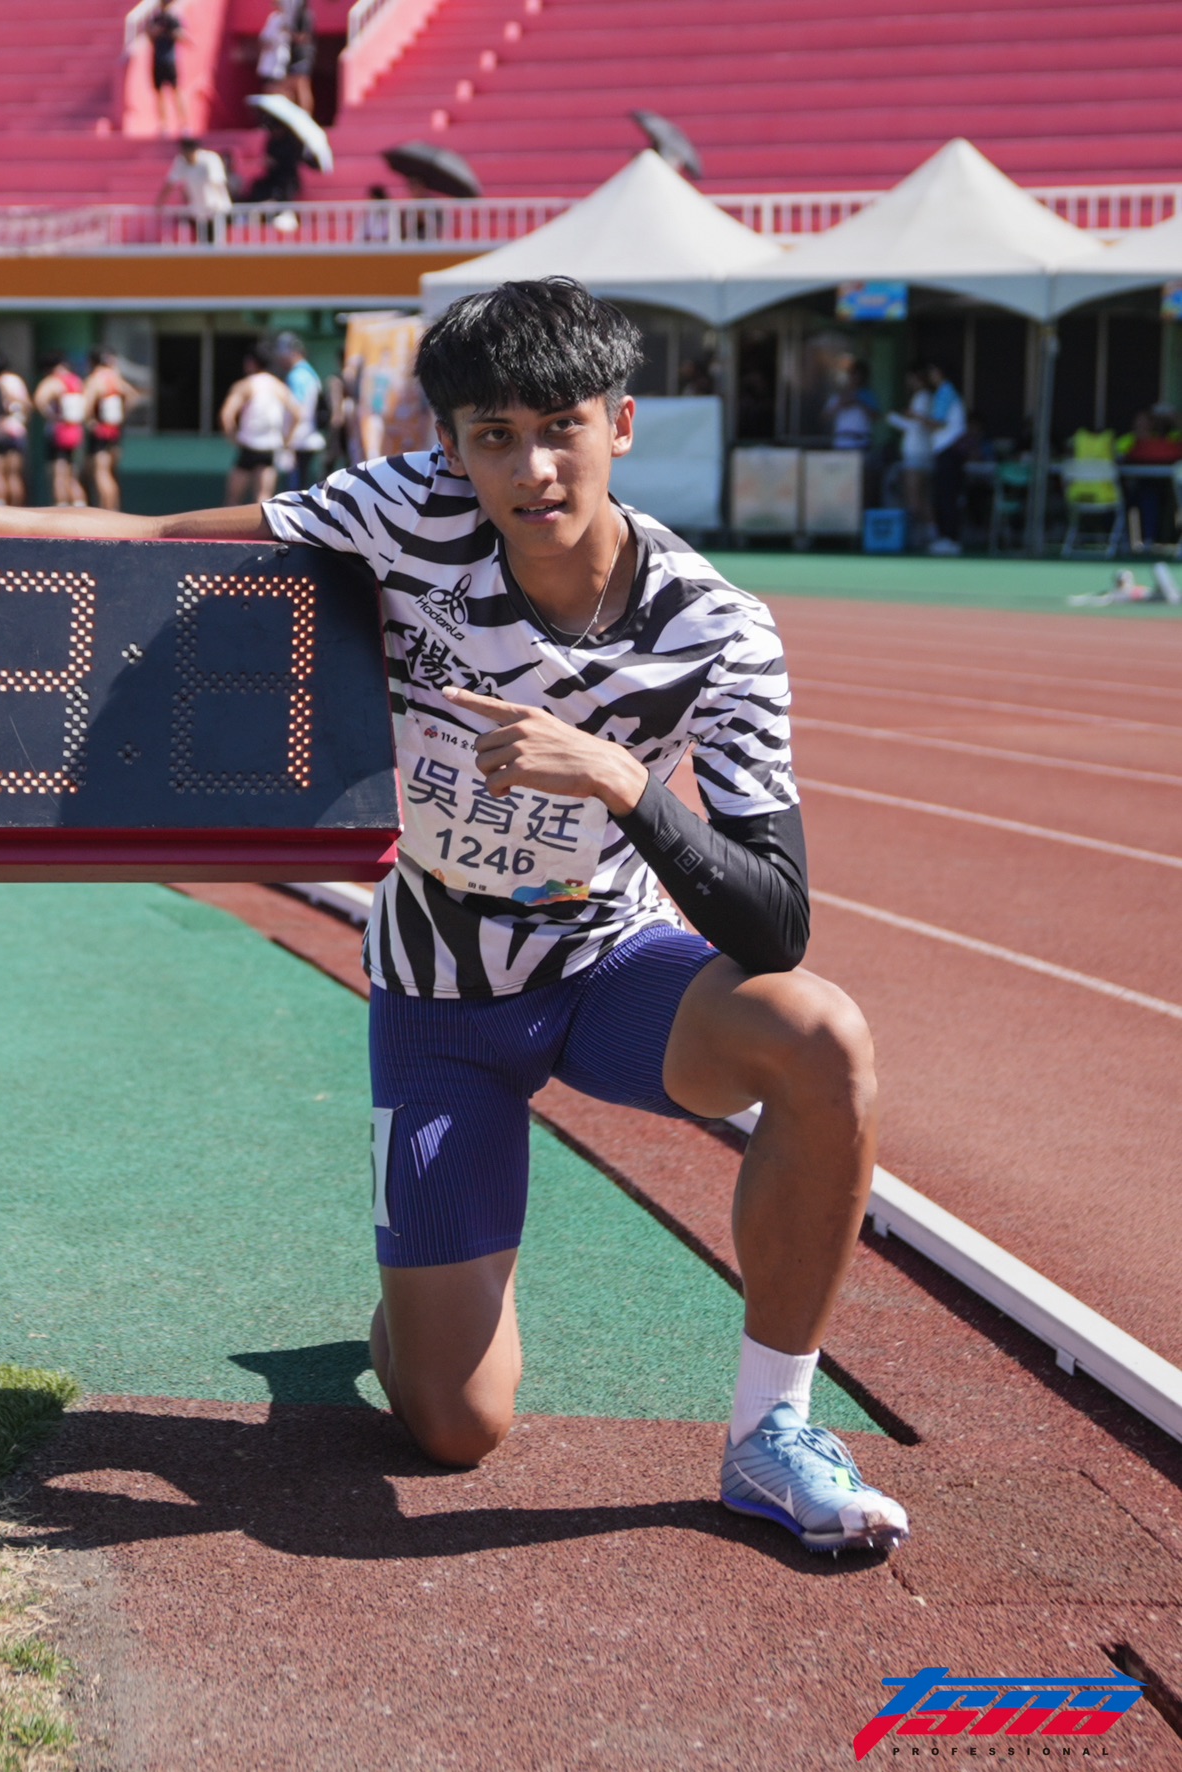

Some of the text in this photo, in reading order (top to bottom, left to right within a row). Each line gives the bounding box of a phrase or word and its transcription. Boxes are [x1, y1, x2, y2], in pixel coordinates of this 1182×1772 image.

[441, 732, 458, 745] 114
[407, 756, 585, 853] 吳育廷
[435, 828, 536, 875] 1246
